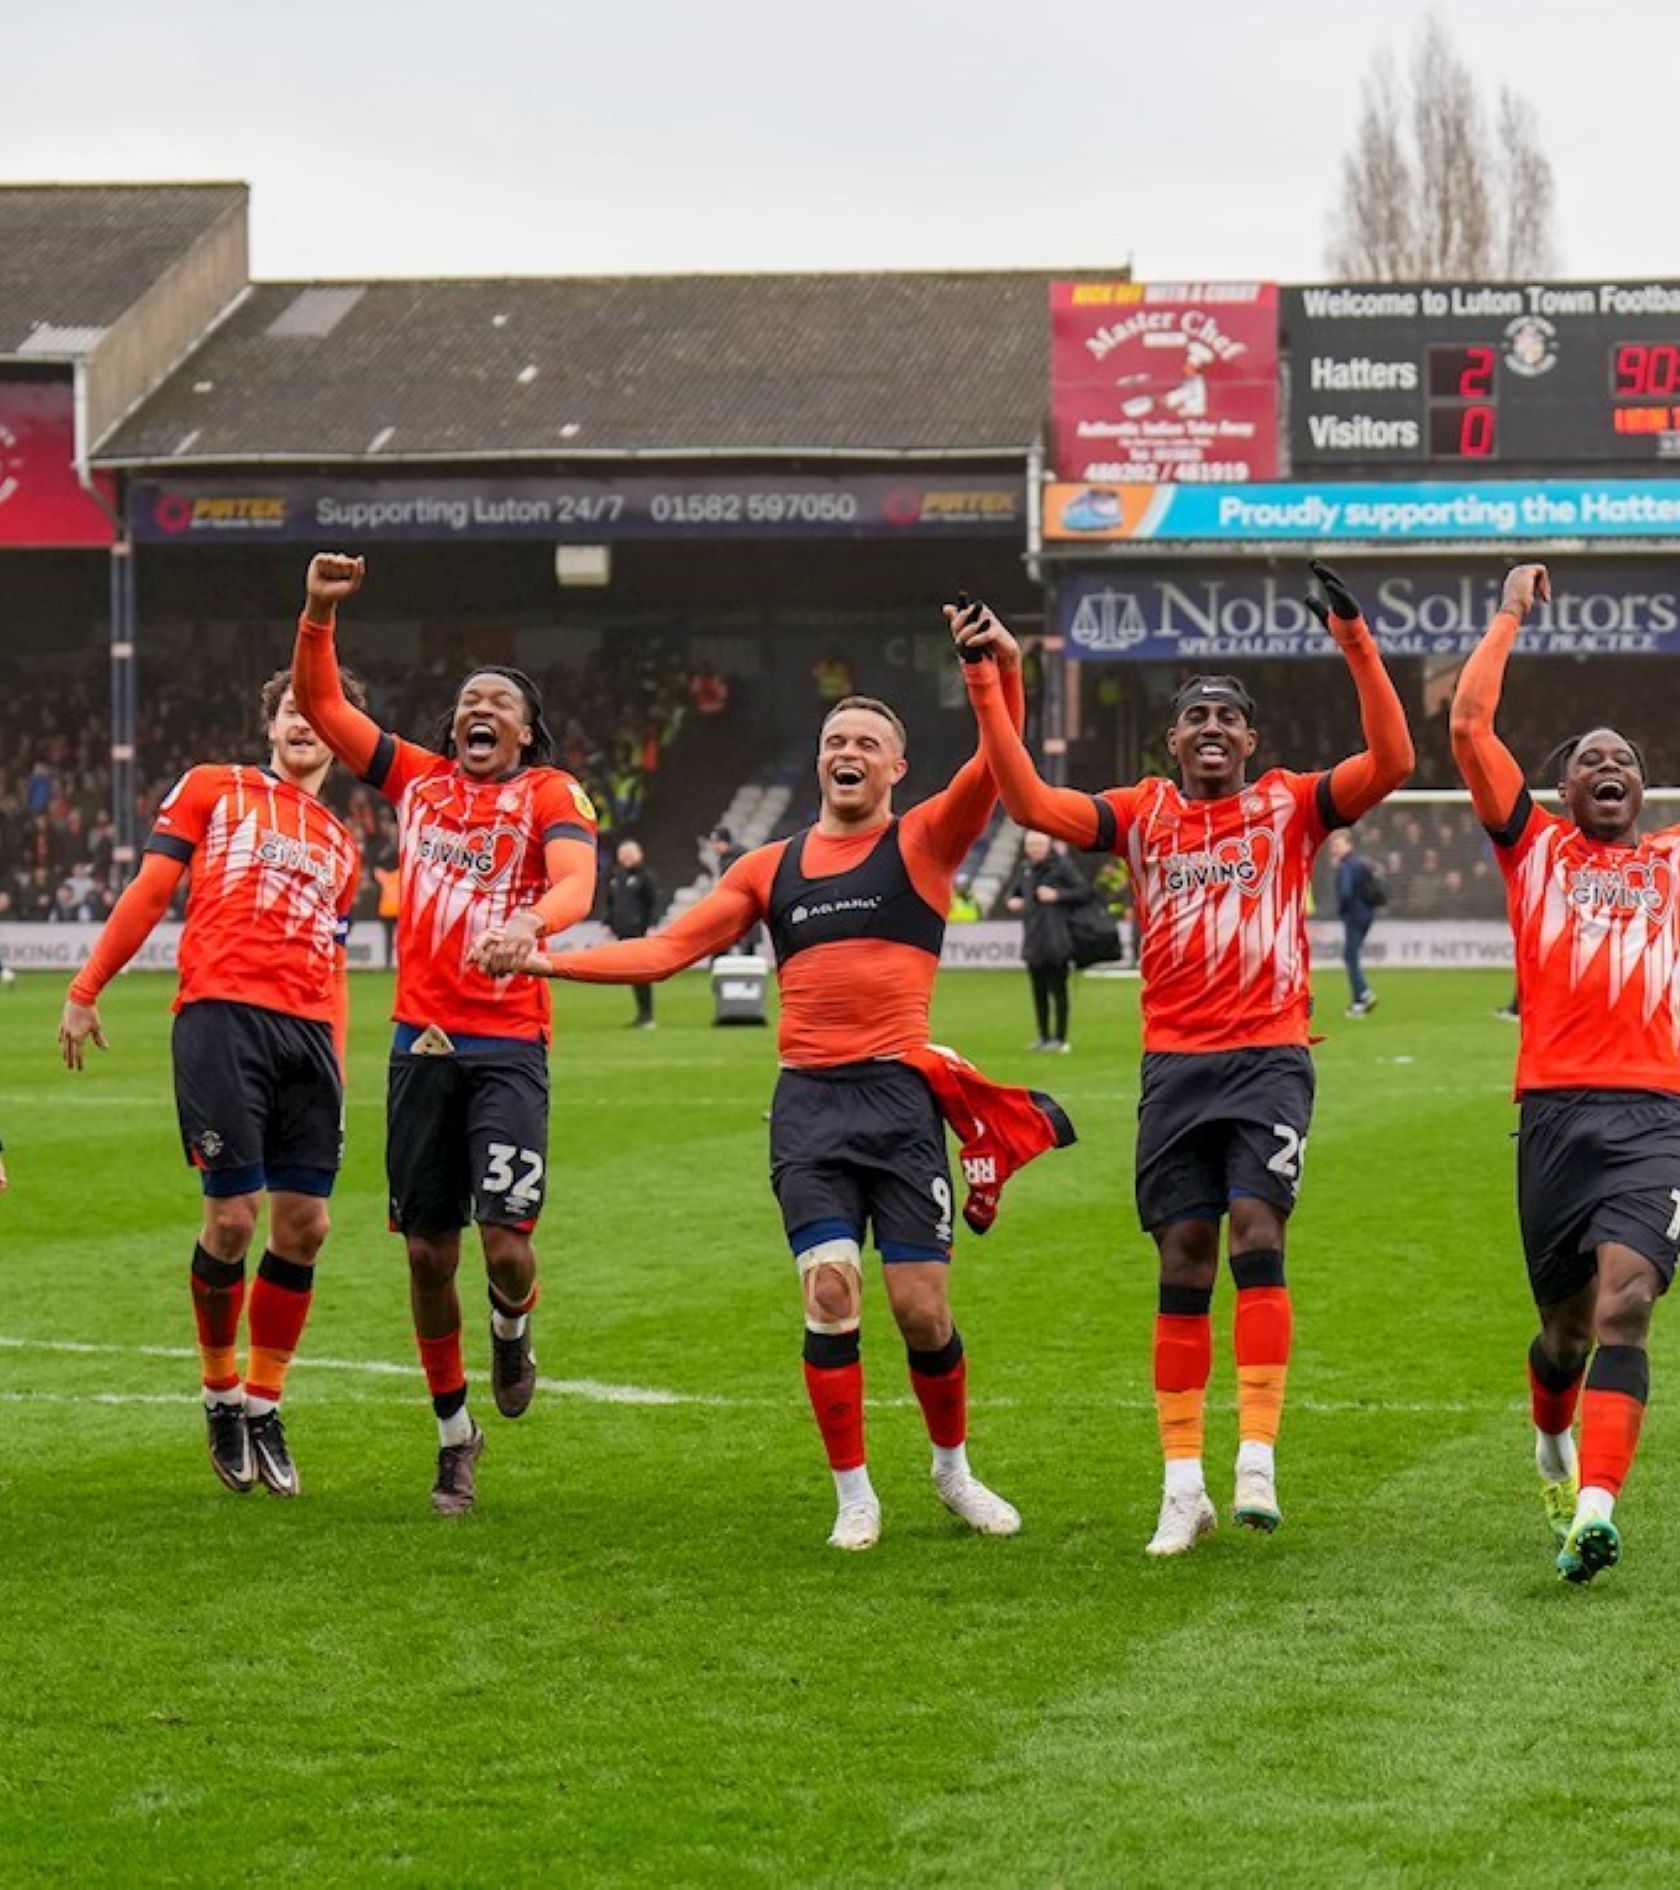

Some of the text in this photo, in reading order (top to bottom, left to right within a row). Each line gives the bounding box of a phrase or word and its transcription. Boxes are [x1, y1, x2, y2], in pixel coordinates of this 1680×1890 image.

[1302, 288, 1417, 318] Welcome
[1421, 288, 1449, 315] to
[1451, 286, 1523, 315] Luton
[1525, 285, 1596, 314] Town
[1085, 309, 1248, 362] Master Chef
[1310, 346, 1495, 398] Hatters 2
[1308, 405, 1495, 457] Visitors 0
[193, 496, 287, 519] PIRTEK
[316, 493, 858, 531] Supporting Luton 24/7 01582 597050
[1219, 495, 1341, 533] Proudly
[1344, 493, 1517, 534] supporting
[1521, 493, 1577, 524] the
[1152, 577, 1335, 638] Nobl
[1376, 575, 1680, 635] Soliitors
[420, 840, 493, 872] GIVING
[1168, 860, 1256, 890] GIVING
[1572, 886, 1661, 909] GIVING
[482, 1142, 545, 1202] 32
[930, 1176, 952, 1224] 9
